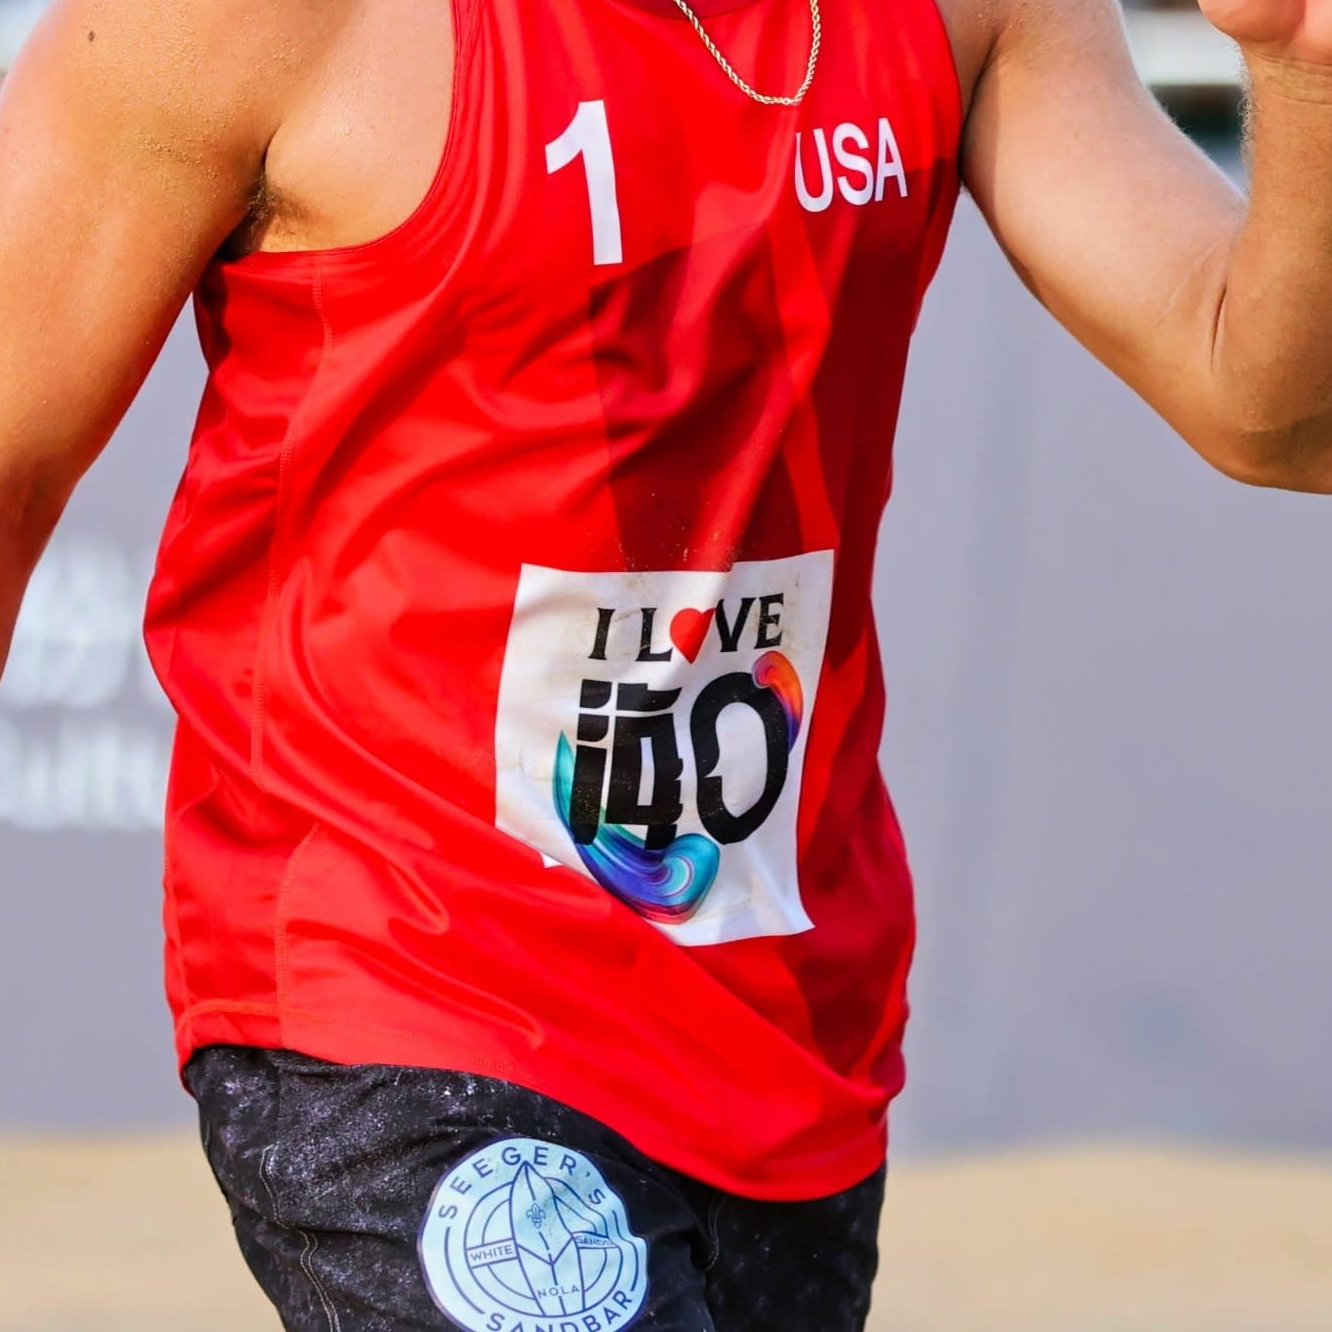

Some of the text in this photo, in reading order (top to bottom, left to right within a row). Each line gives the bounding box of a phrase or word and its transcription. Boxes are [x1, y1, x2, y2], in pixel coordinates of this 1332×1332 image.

[546, 100, 622, 264] 1
[795, 118, 907, 212] USA
[587, 606, 617, 661] I
[438, 1146, 606, 1220] SEEGER'S
[470, 1244, 514, 1262] WHITE
[486, 1289, 634, 1332] SANDBAR
[537, 1284, 580, 1299] NOLA
